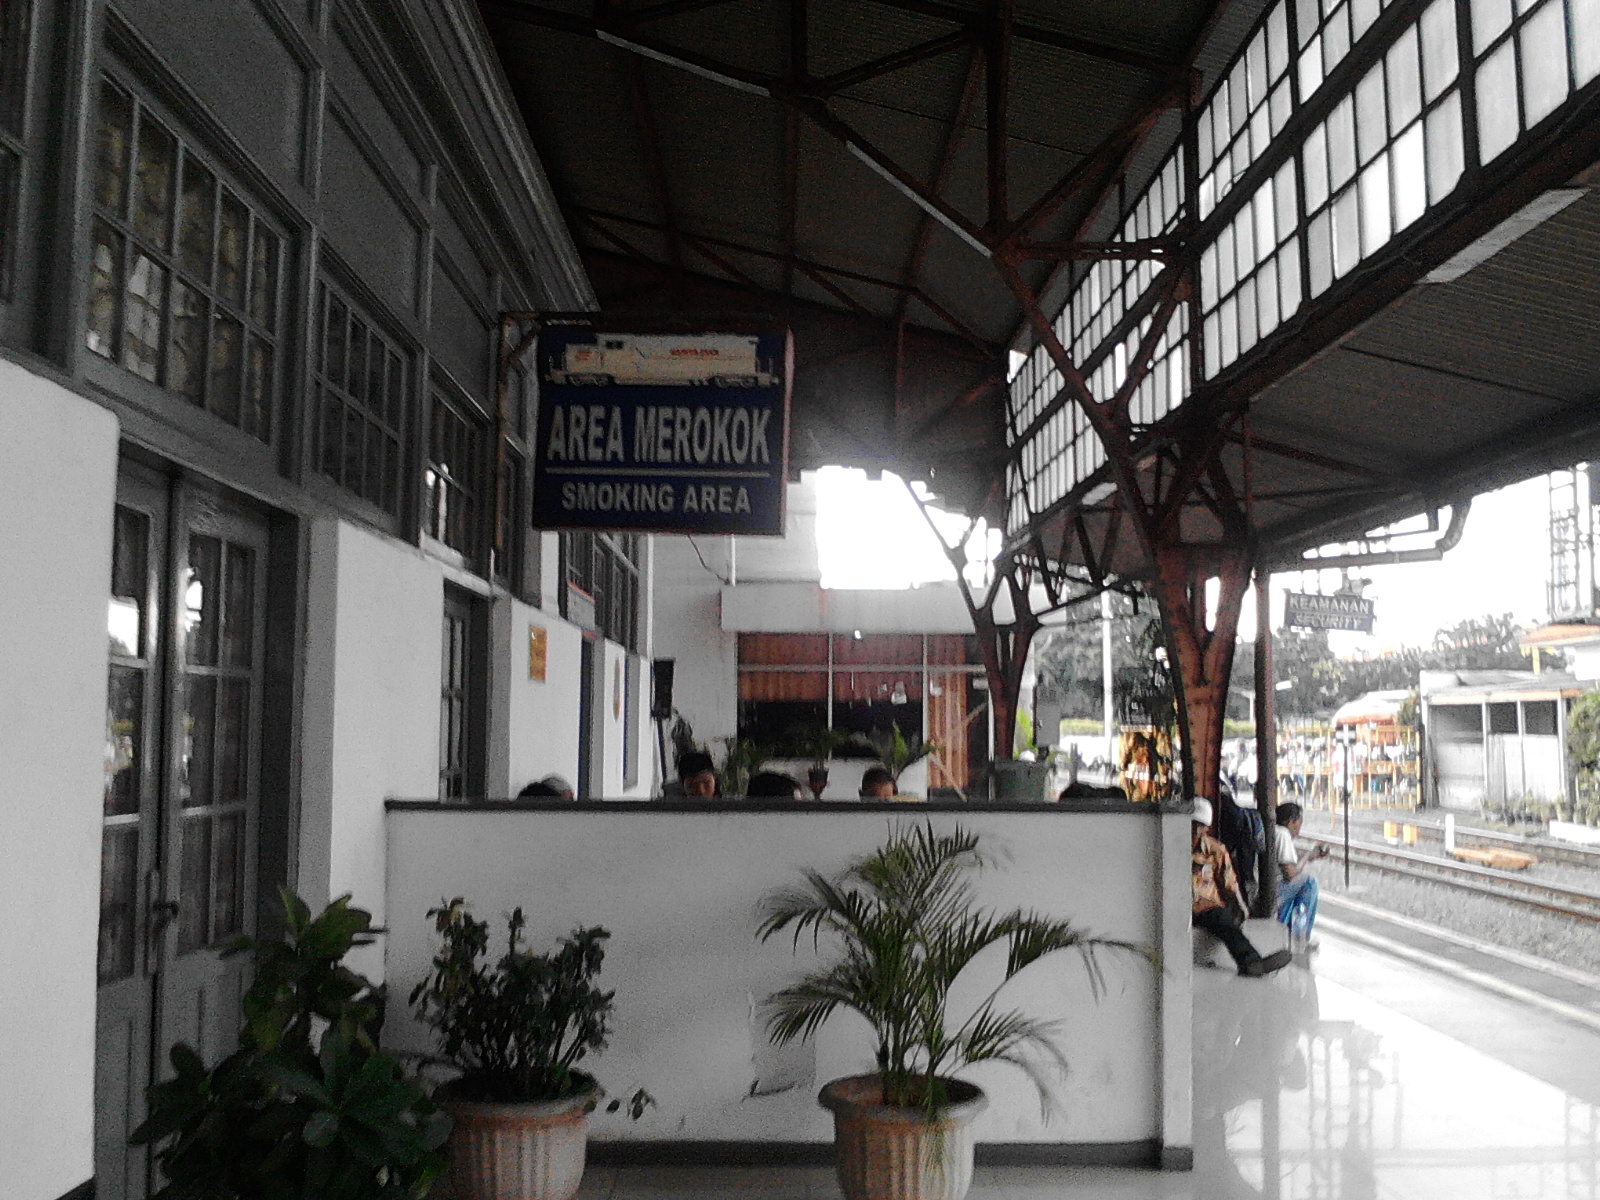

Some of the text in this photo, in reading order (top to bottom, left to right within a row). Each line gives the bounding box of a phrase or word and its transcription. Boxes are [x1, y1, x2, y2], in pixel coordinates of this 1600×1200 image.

[547, 405, 771, 464] AREA MEROKOK
[561, 481, 751, 514] SMOKING AREA
[1289, 595, 1369, 614] KEAMANAN
